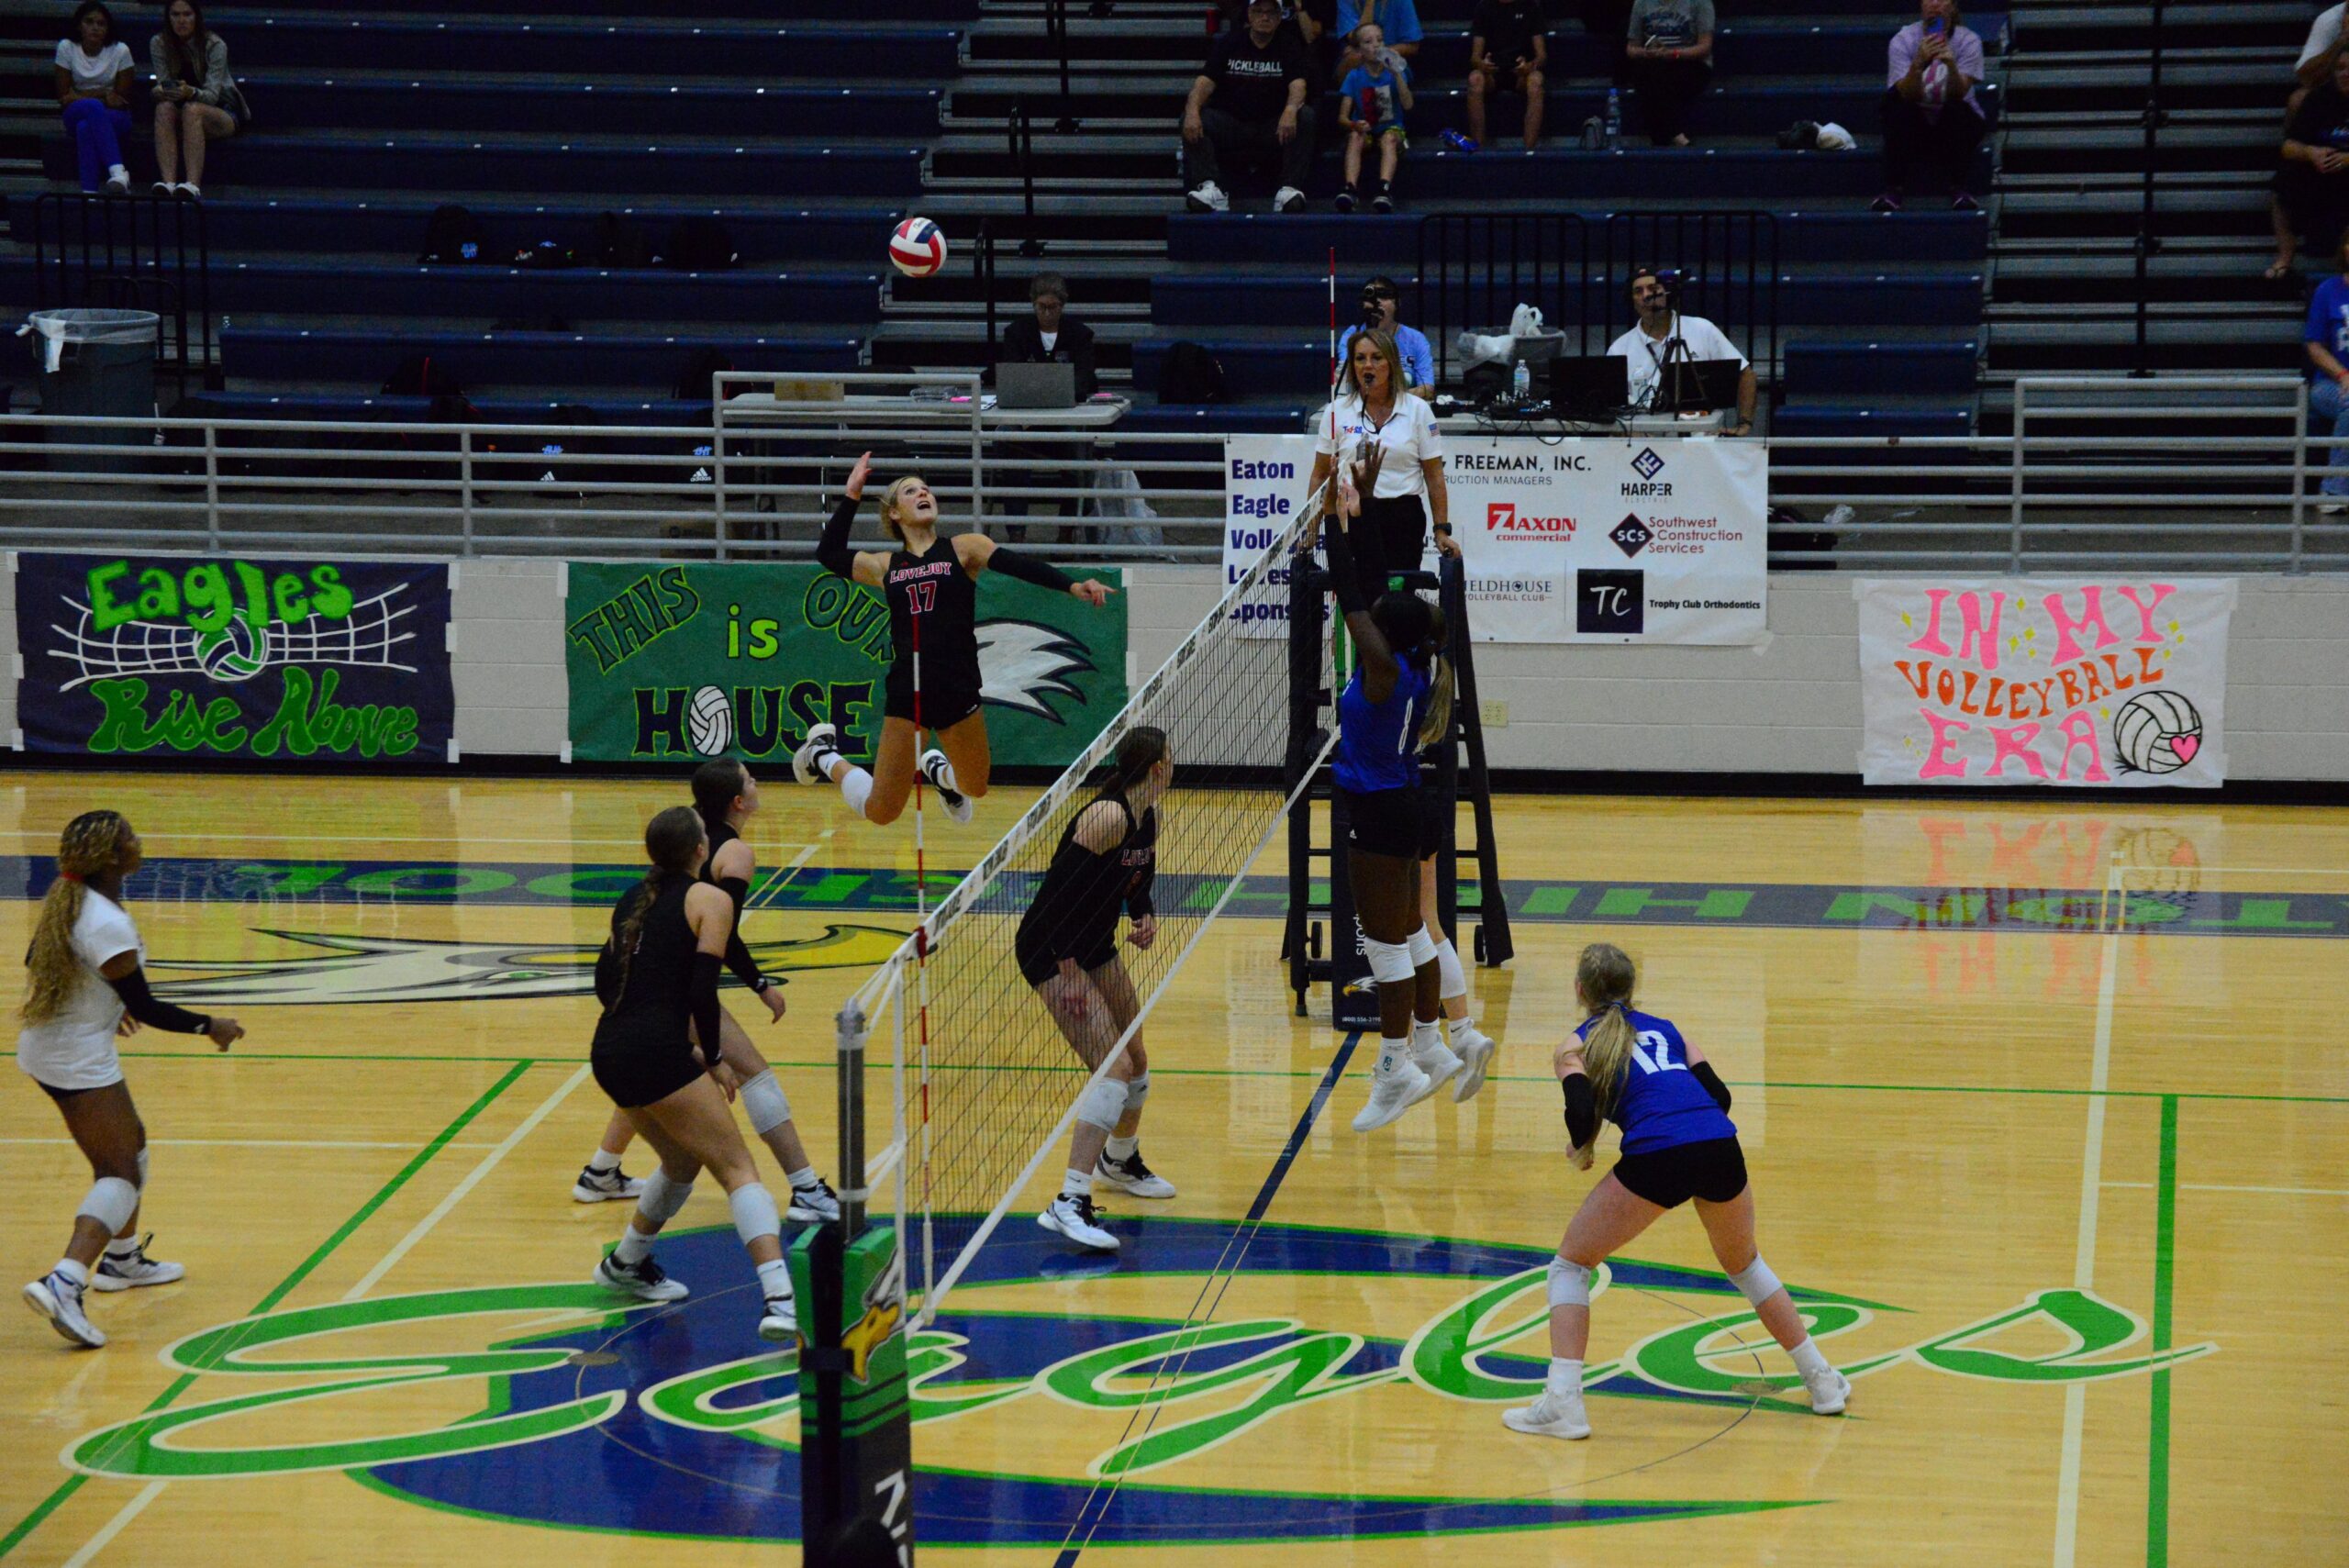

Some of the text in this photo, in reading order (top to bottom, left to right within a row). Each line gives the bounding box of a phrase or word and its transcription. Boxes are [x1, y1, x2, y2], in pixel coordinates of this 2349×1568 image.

[1231, 459, 1294, 479] Eaton
[1453, 454, 1592, 473] FREEMAN, INC.
[1443, 475, 1553, 486] RUCTION MANAGERS
[1620, 483, 1673, 497] HARPER
[1231, 493, 1290, 518] Eagle
[1648, 516, 1718, 528] Southwest
[1496, 533, 1572, 542] commercial
[1616, 528, 1647, 543] SCS
[1657, 528, 1743, 541] Construction
[1648, 542, 1705, 554] Services
[890, 562, 952, 584] LOVEJOY
[1228, 564, 1291, 585] Les
[87, 560, 354, 633] Eagles
[906, 580, 937, 615] 17
[1464, 580, 1553, 594] IELDHOUSE
[1520, 594, 1544, 602] CLUB
[1590, 585, 1631, 617] TC
[1649, 599, 1761, 610] Trophy Club Orthodontics
[567, 565, 700, 675] THIS
[727, 603, 779, 661] is
[1228, 602, 1330, 624] ponss
[1908, 584, 2177, 671] IN MY
[1893, 646, 2165, 720] VOLLEYBALL
[87, 666, 419, 758] Rise Above
[631, 680, 875, 758] HOUSE
[1918, 707, 2111, 783] ERA
[1631, 1029, 1688, 1075] 12
